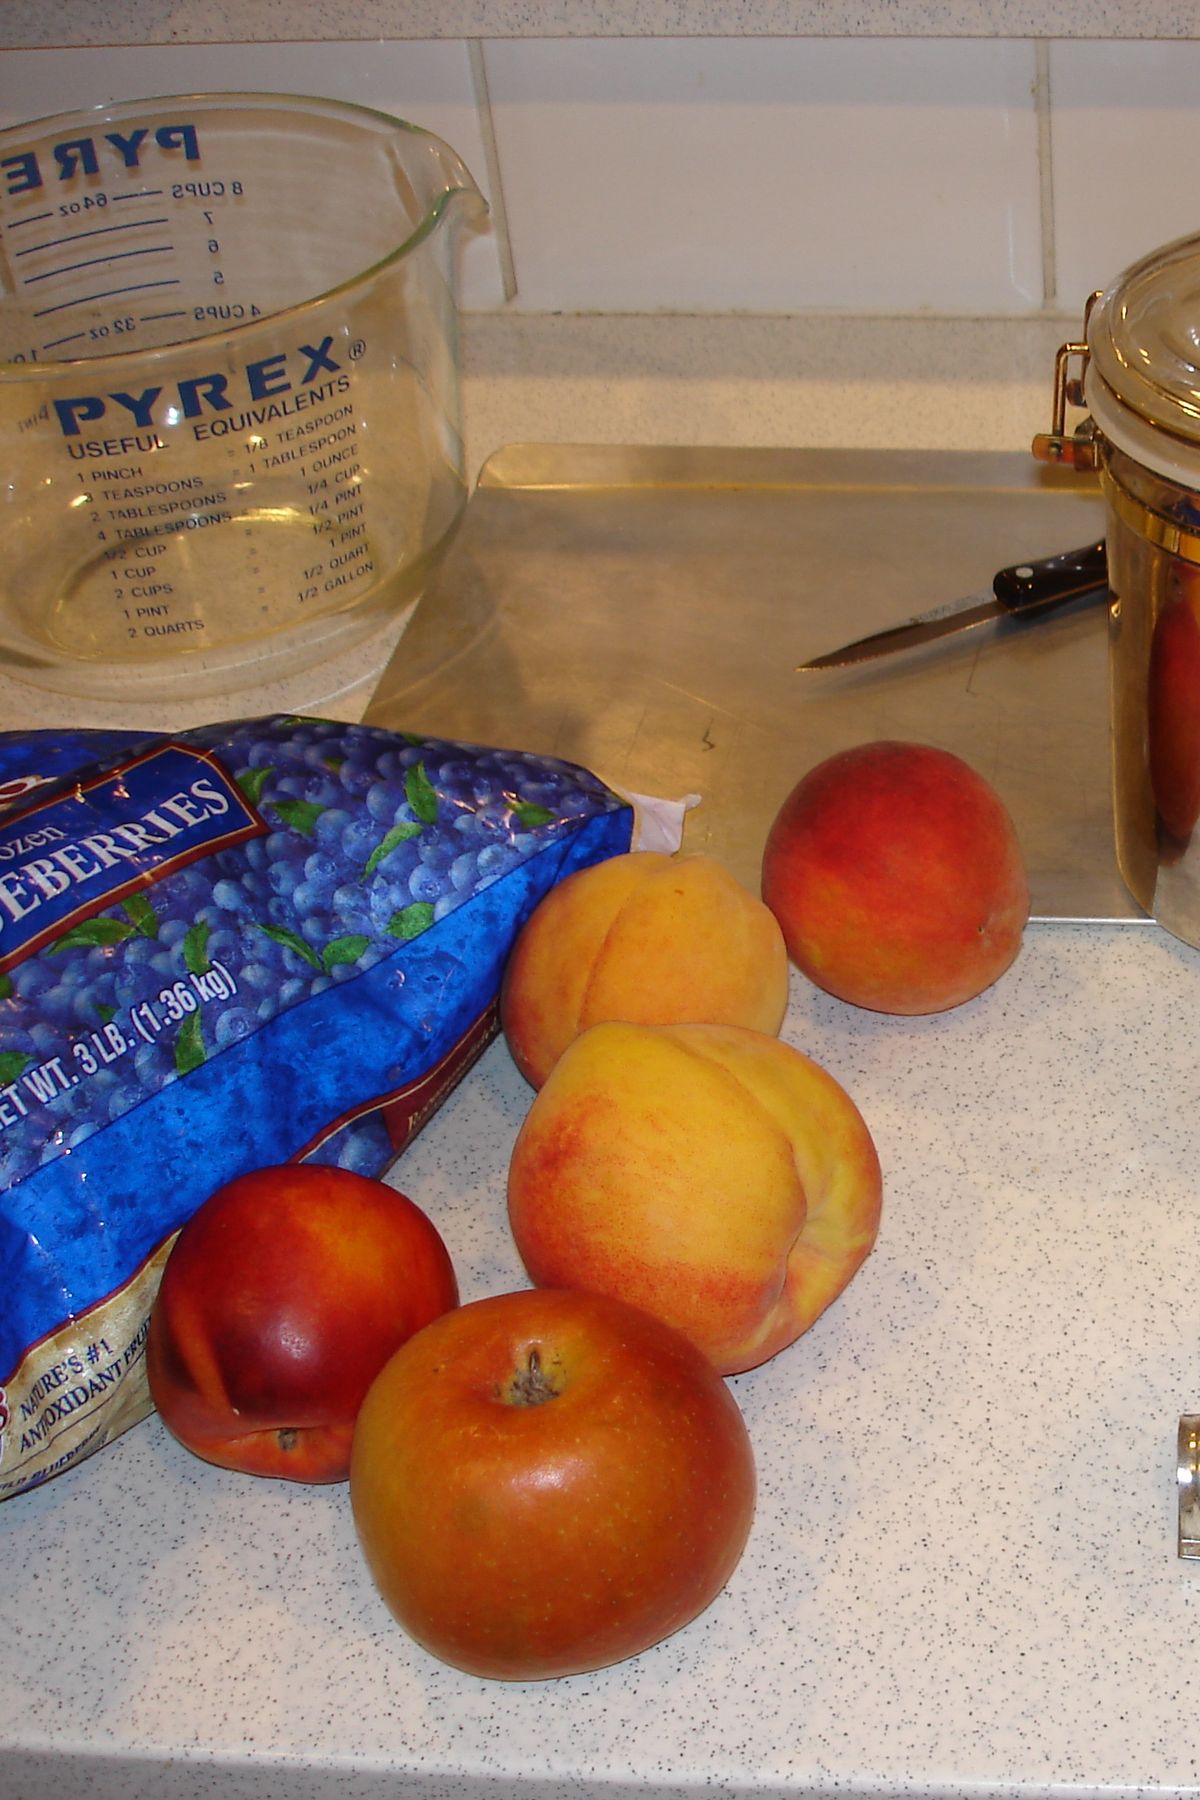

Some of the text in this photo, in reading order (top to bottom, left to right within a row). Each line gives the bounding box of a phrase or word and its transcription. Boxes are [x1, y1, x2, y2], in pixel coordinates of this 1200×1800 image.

[53, 336, 341, 436] PYREX
[67, 375, 351, 460] USEFUL EQUIVALENTS
[92, 466, 144, 482] PINCH
[277, 404, 354, 444] TEASPOON
[103, 476, 204, 501] TEASPOONS
[263, 424, 356, 469] TABLESPOON
[109, 492, 227, 521] TABLESPOONS
[313, 443, 358, 473] OUNCE
[116, 511, 232, 540] TABLESPOONS
[335, 463, 361, 484] CUP
[124, 566, 156, 580] CUP
[338, 503, 365, 525] PINT
[135, 544, 167, 559] CUP
[335, 484, 363, 505] PINT
[131, 583, 174, 598] CUPS
[341, 523, 367, 544] PINT
[136, 604, 169, 618] PINT
[330, 542, 370, 568] QUART
[144, 619, 205, 638] QUARTS
[324, 560, 374, 592] GALLON
[0, 778, 230, 932] EBERRIES
[0, 960, 238, 1129] ET WT. 3 LB. (1.36 kg)
[86, 1338, 112, 1365] #1
